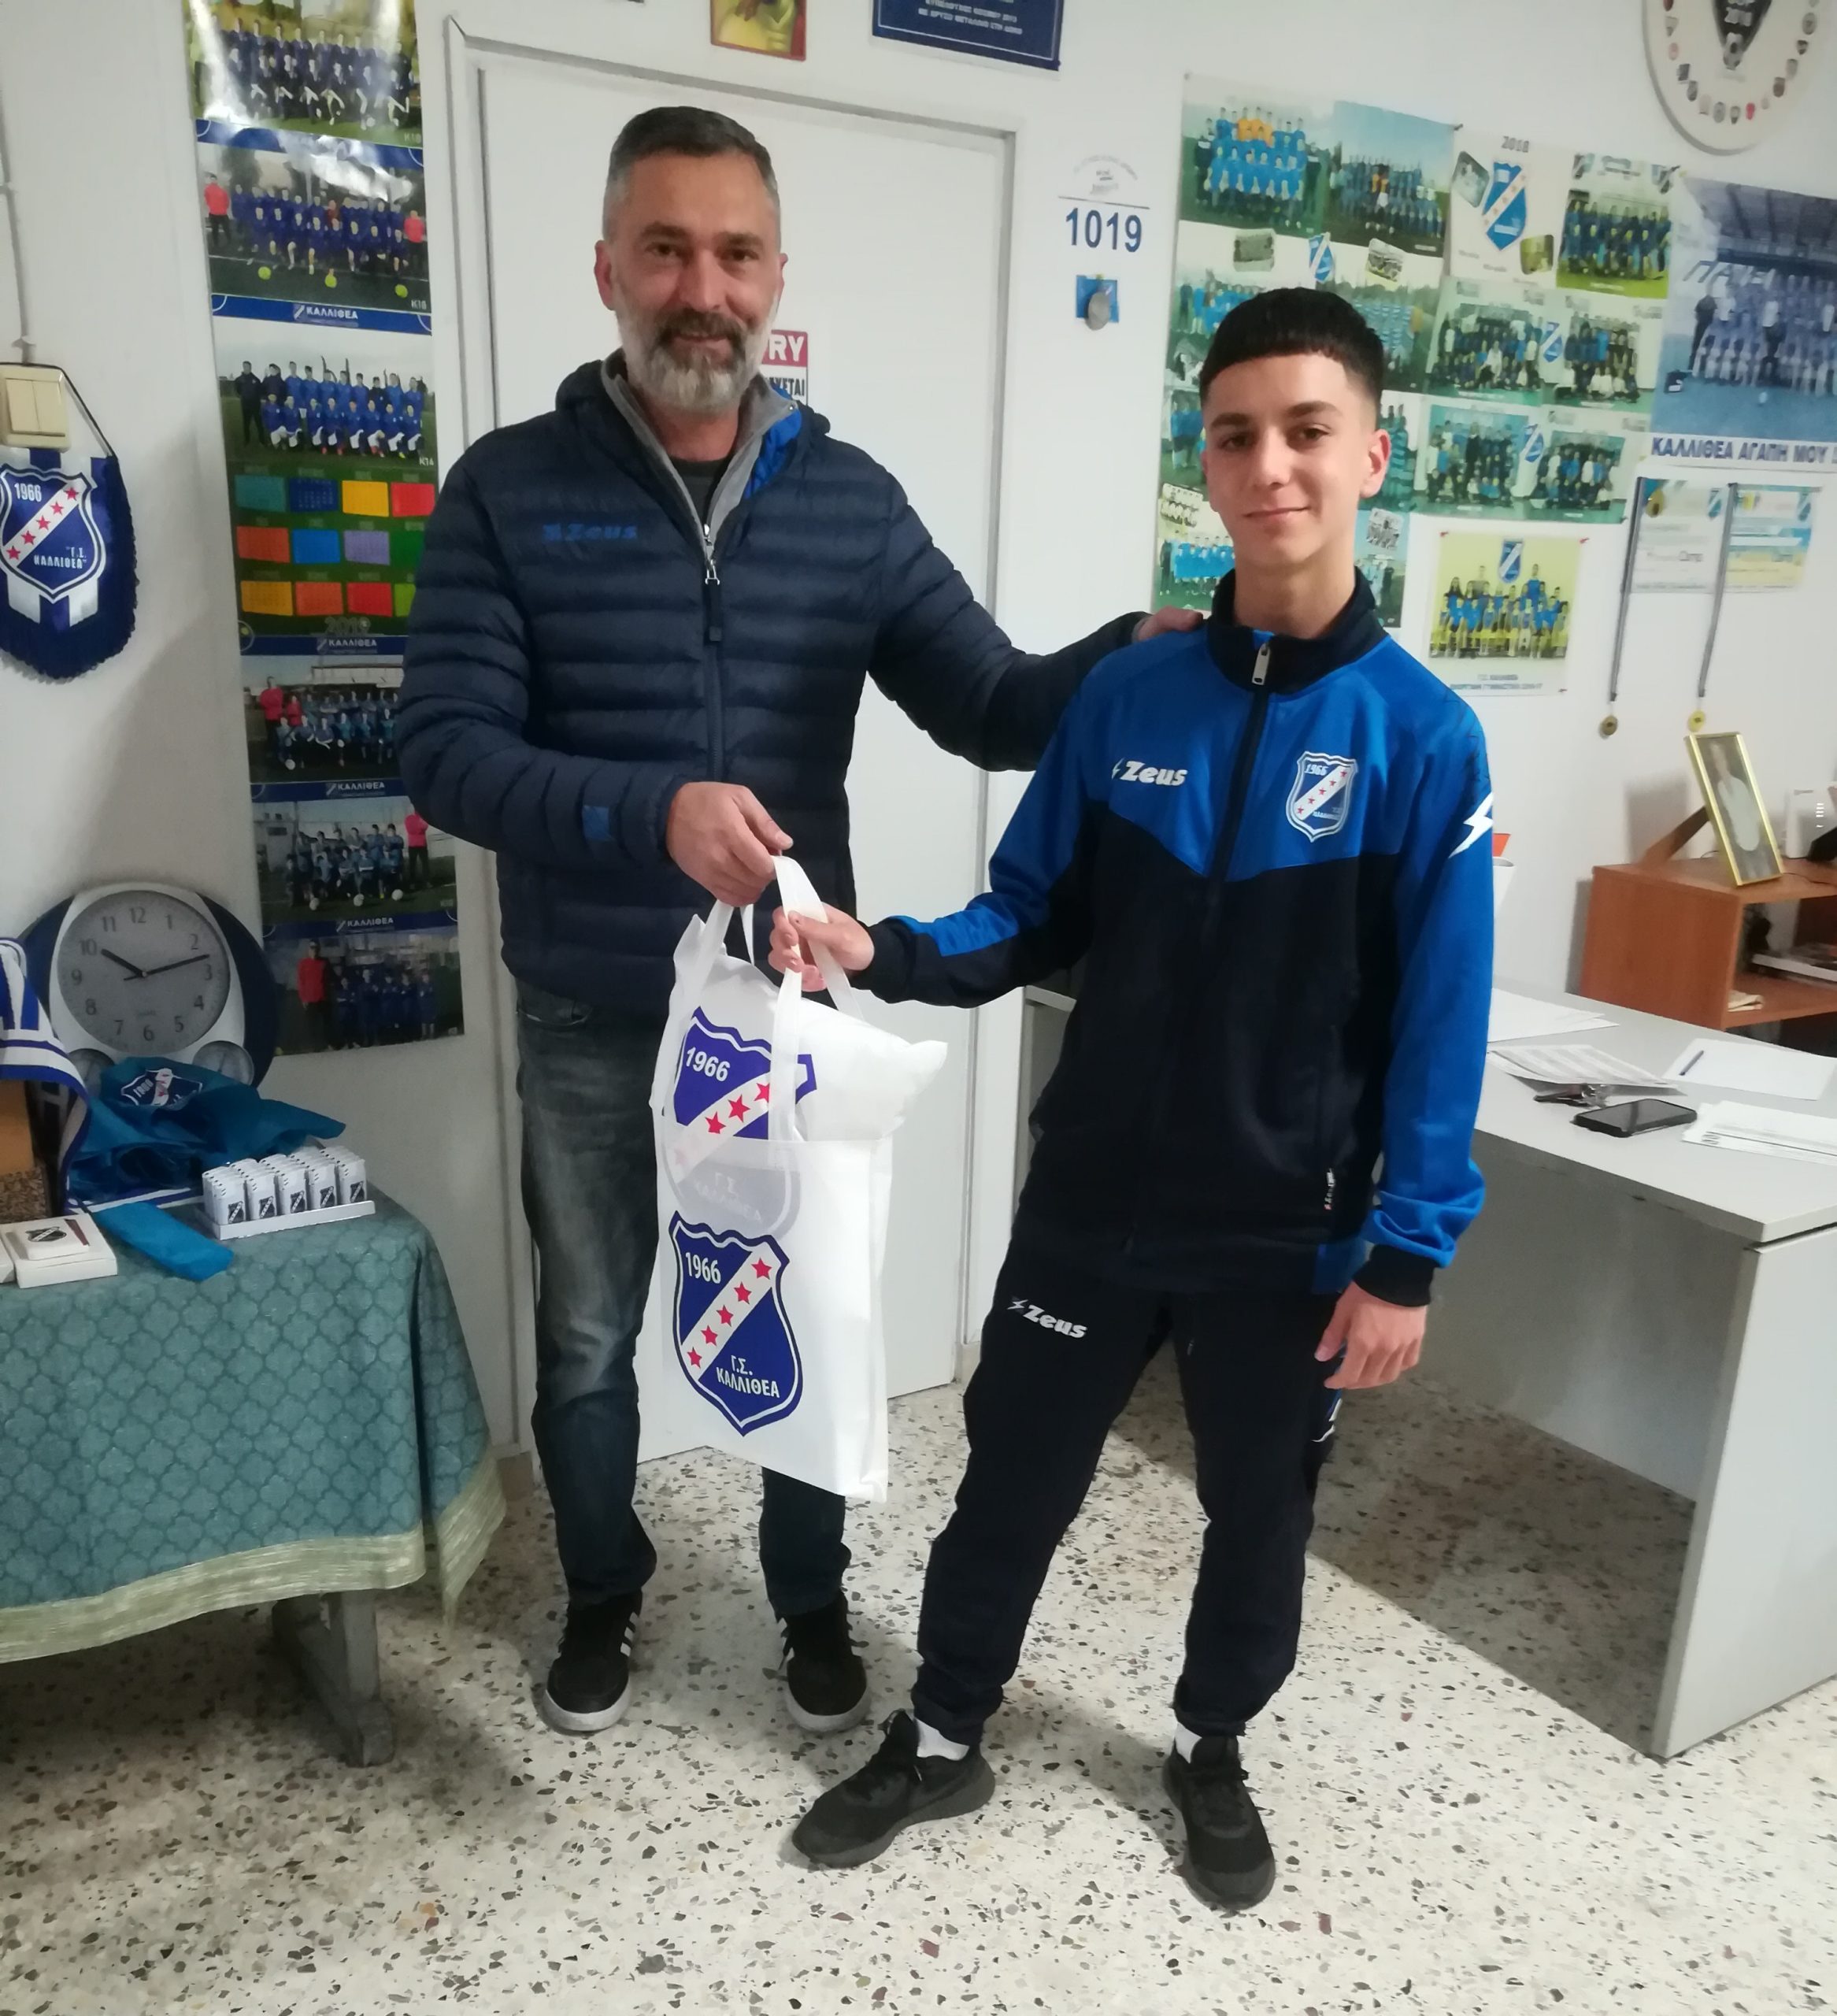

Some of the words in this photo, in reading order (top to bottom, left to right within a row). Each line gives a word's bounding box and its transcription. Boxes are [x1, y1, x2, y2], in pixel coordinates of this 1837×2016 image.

[1065, 207, 1142, 253] 1019
[306, 306, 358, 320] ΚΑΛΛΙΘΕΑ
[769, 335, 804, 362] RY
[1651, 437, 1733, 460] ΚΑΛΛΙΘΕΑ
[1738, 442, 1788, 462] ΑΓΑΠΗ
[14, 483, 42, 502] 1966
[328, 639, 377, 647] ΚΑΛΛΙΘΕΑ
[1120, 760, 1187, 786] Zeus
[129, 906, 146, 923] 12
[165, 914, 172, 930] 1
[102, 916, 116, 932] 11
[80, 939, 97, 955] 10
[189, 933, 198, 950] 2
[72, 969, 83, 984] 9
[205, 964, 213, 980] 3
[85, 999, 97, 1015] 8
[194, 995, 204, 1010] 4
[114, 1020, 124, 1036] 7
[143, 1024, 154, 1041] 6
[174, 1016, 184, 1032] 5
[686, 1047, 731, 1082] 1966
[685, 1252, 721, 1284] 1966
[1023, 1304, 1087, 1338] Zeus
[731, 1354, 754, 1377] Γ.Σ.
[716, 1366, 780, 1399] ΚΑΛΛΙΘΕΑ
